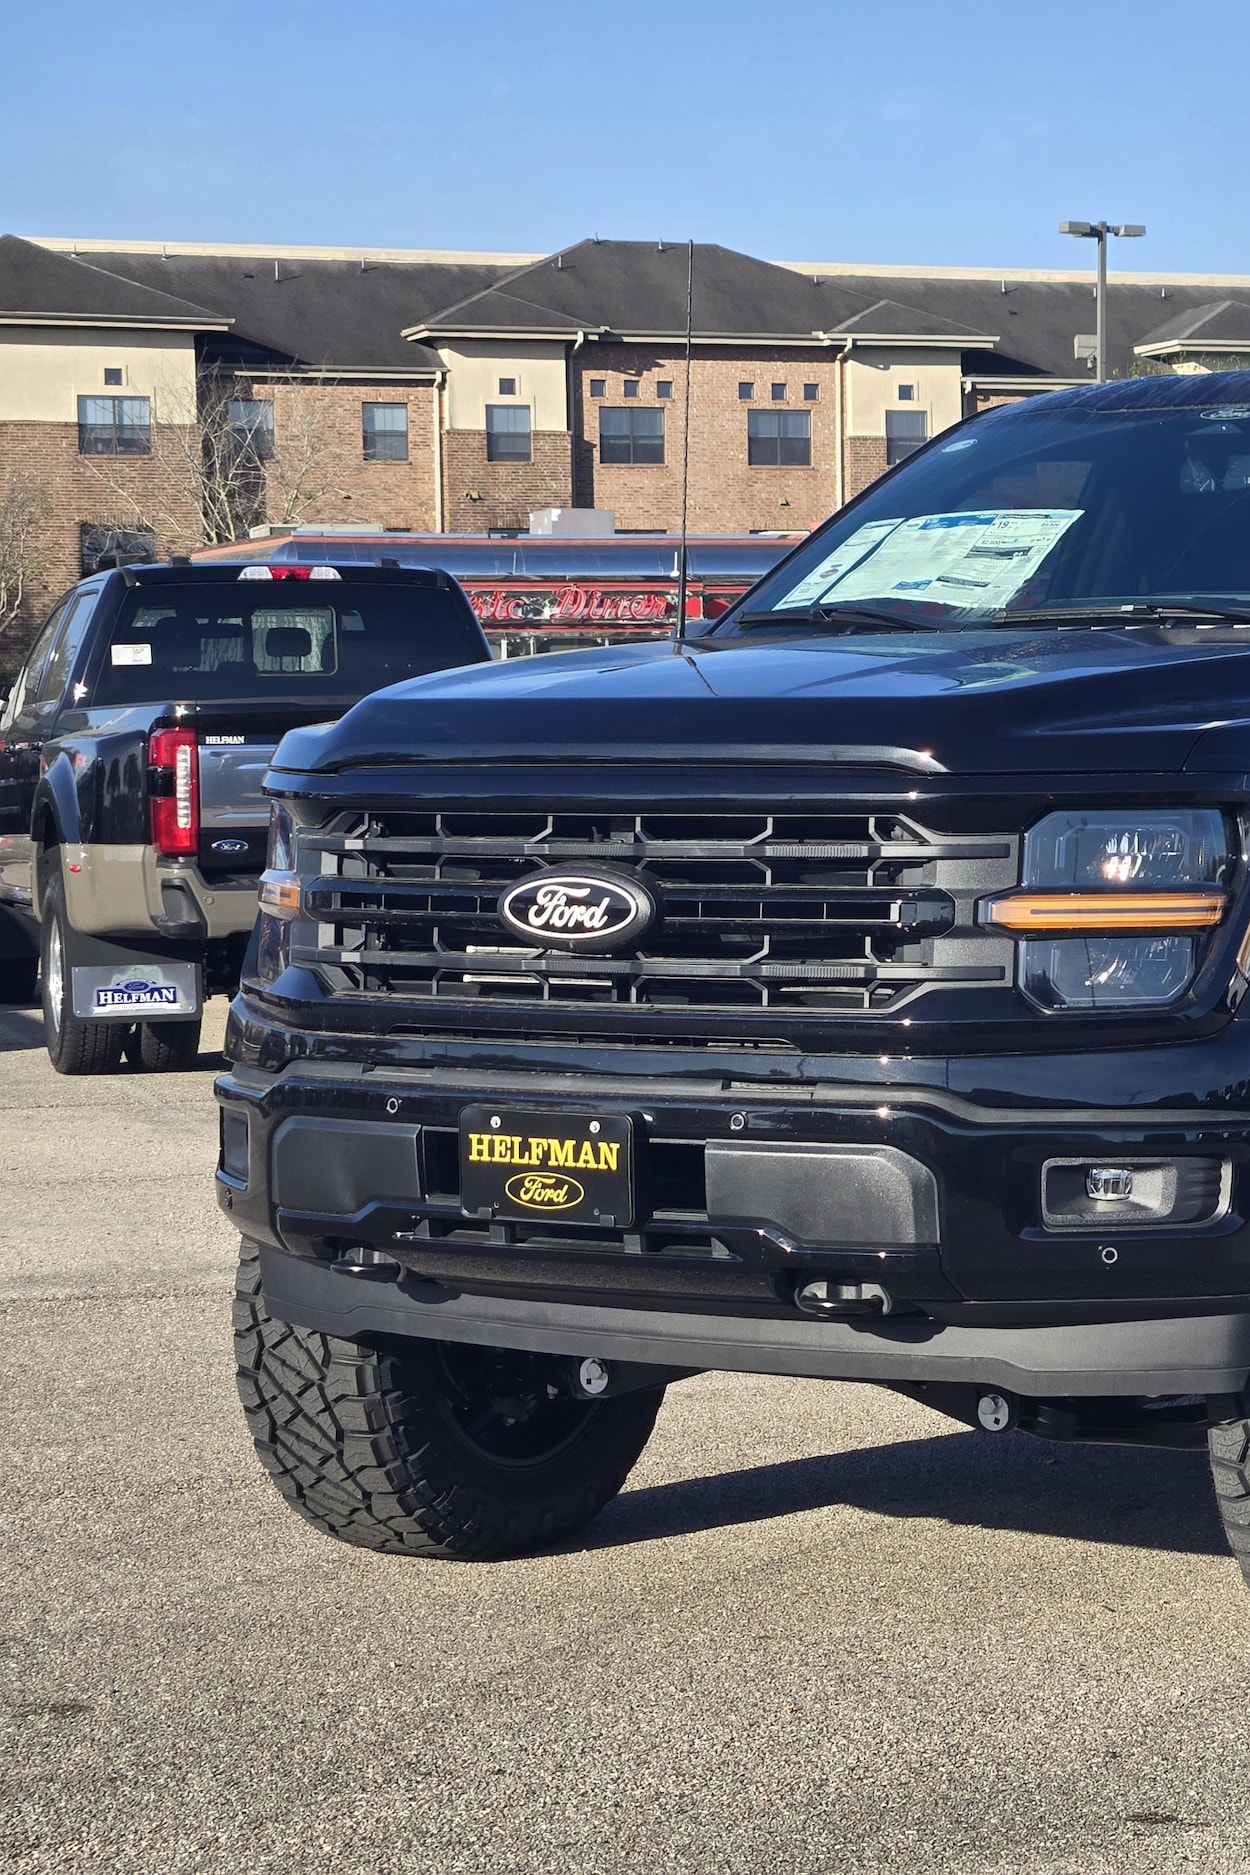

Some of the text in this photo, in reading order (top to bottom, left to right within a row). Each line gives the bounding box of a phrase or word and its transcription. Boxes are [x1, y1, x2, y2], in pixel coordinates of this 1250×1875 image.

[551, 584, 669, 619] Diner
[205, 735, 245, 745] HELFMAN
[528, 885, 611, 929] Ford
[98, 988, 175, 1005] HELFMAN
[468, 1133, 621, 1171] HELFMAN
[519, 1175, 570, 1204] Ford
